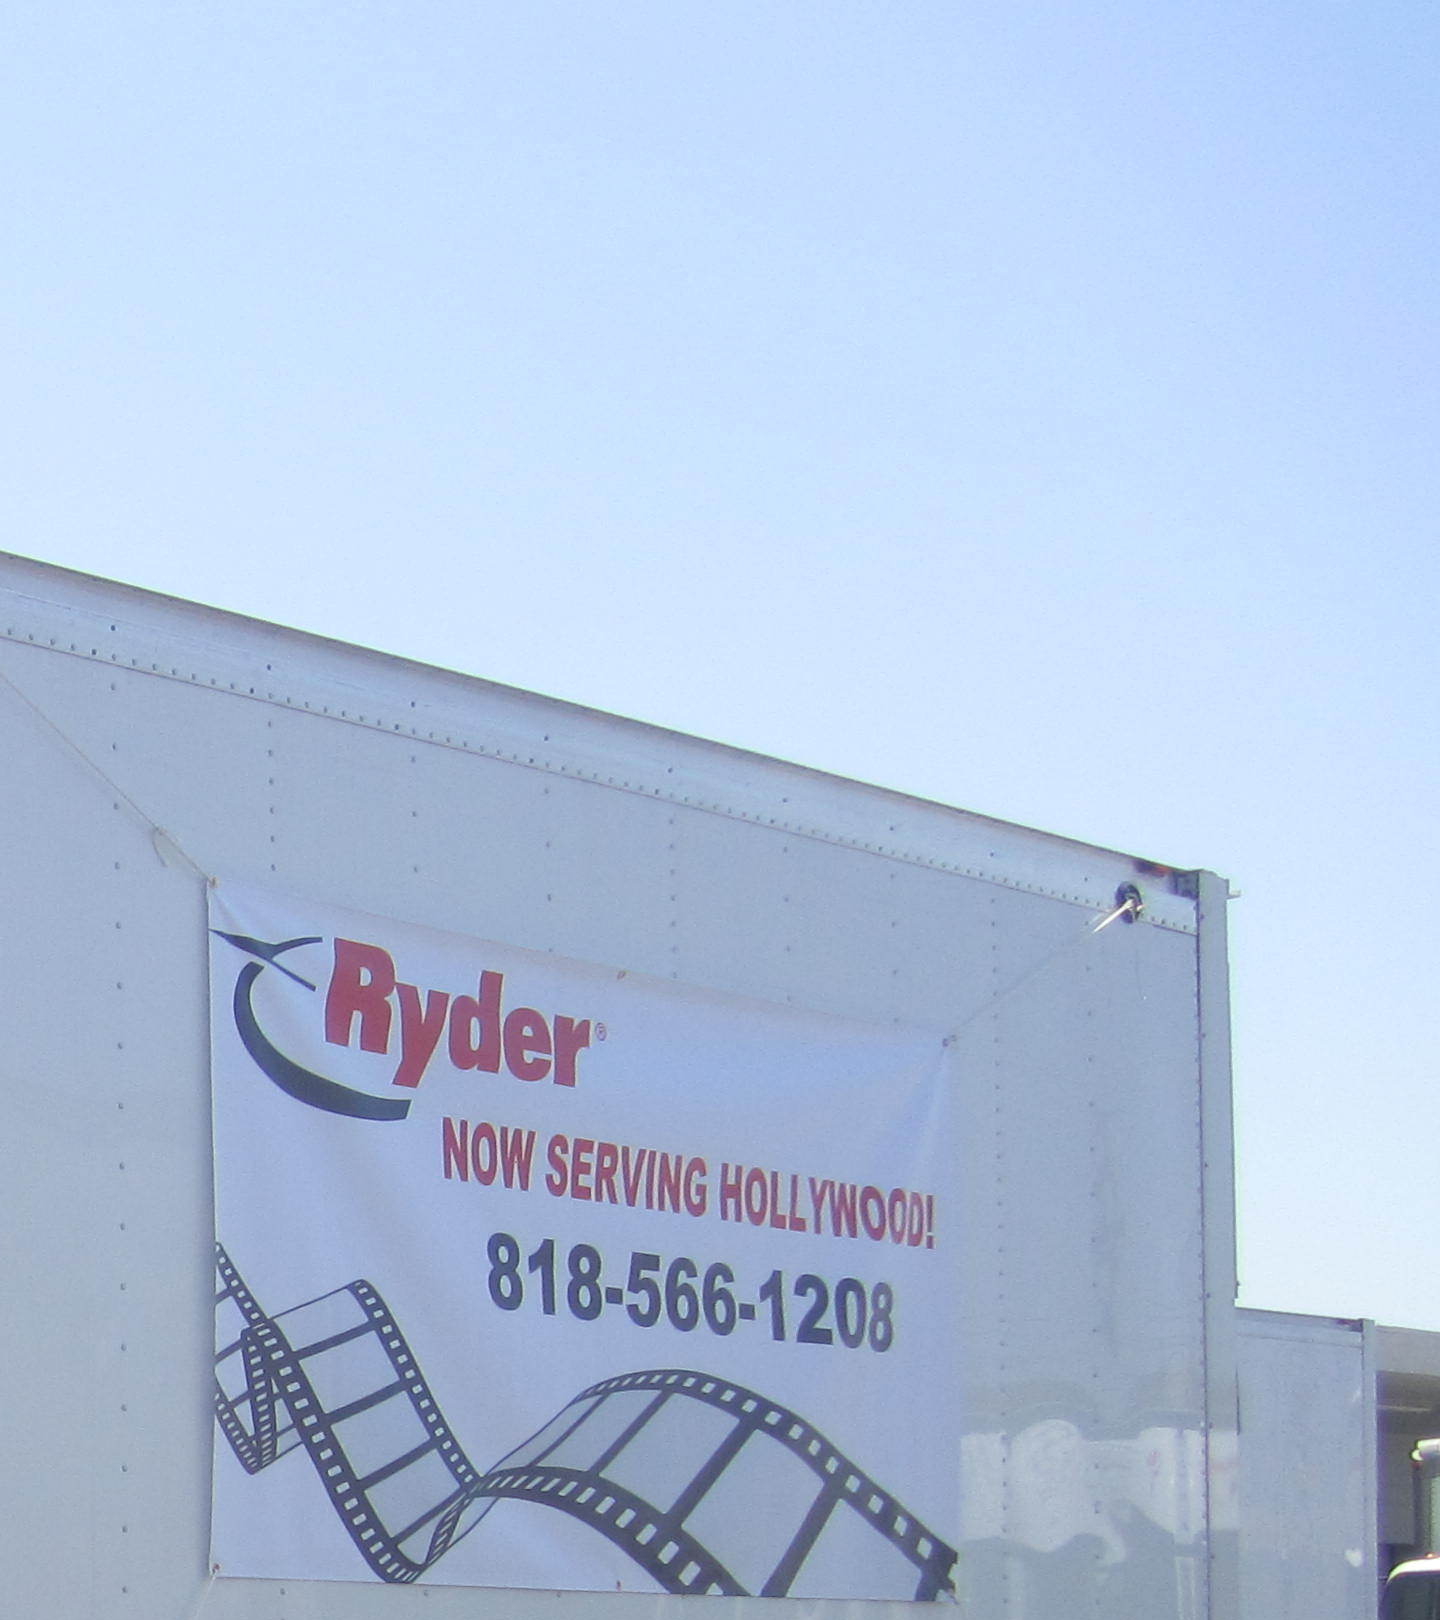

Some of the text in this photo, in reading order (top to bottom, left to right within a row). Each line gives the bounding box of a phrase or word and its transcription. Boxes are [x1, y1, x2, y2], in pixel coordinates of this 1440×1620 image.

[442, 1116, 936, 1250] NOW SERVING HOLLYWOOD!
[486, 1232, 894, 1353] 818-566-1208
